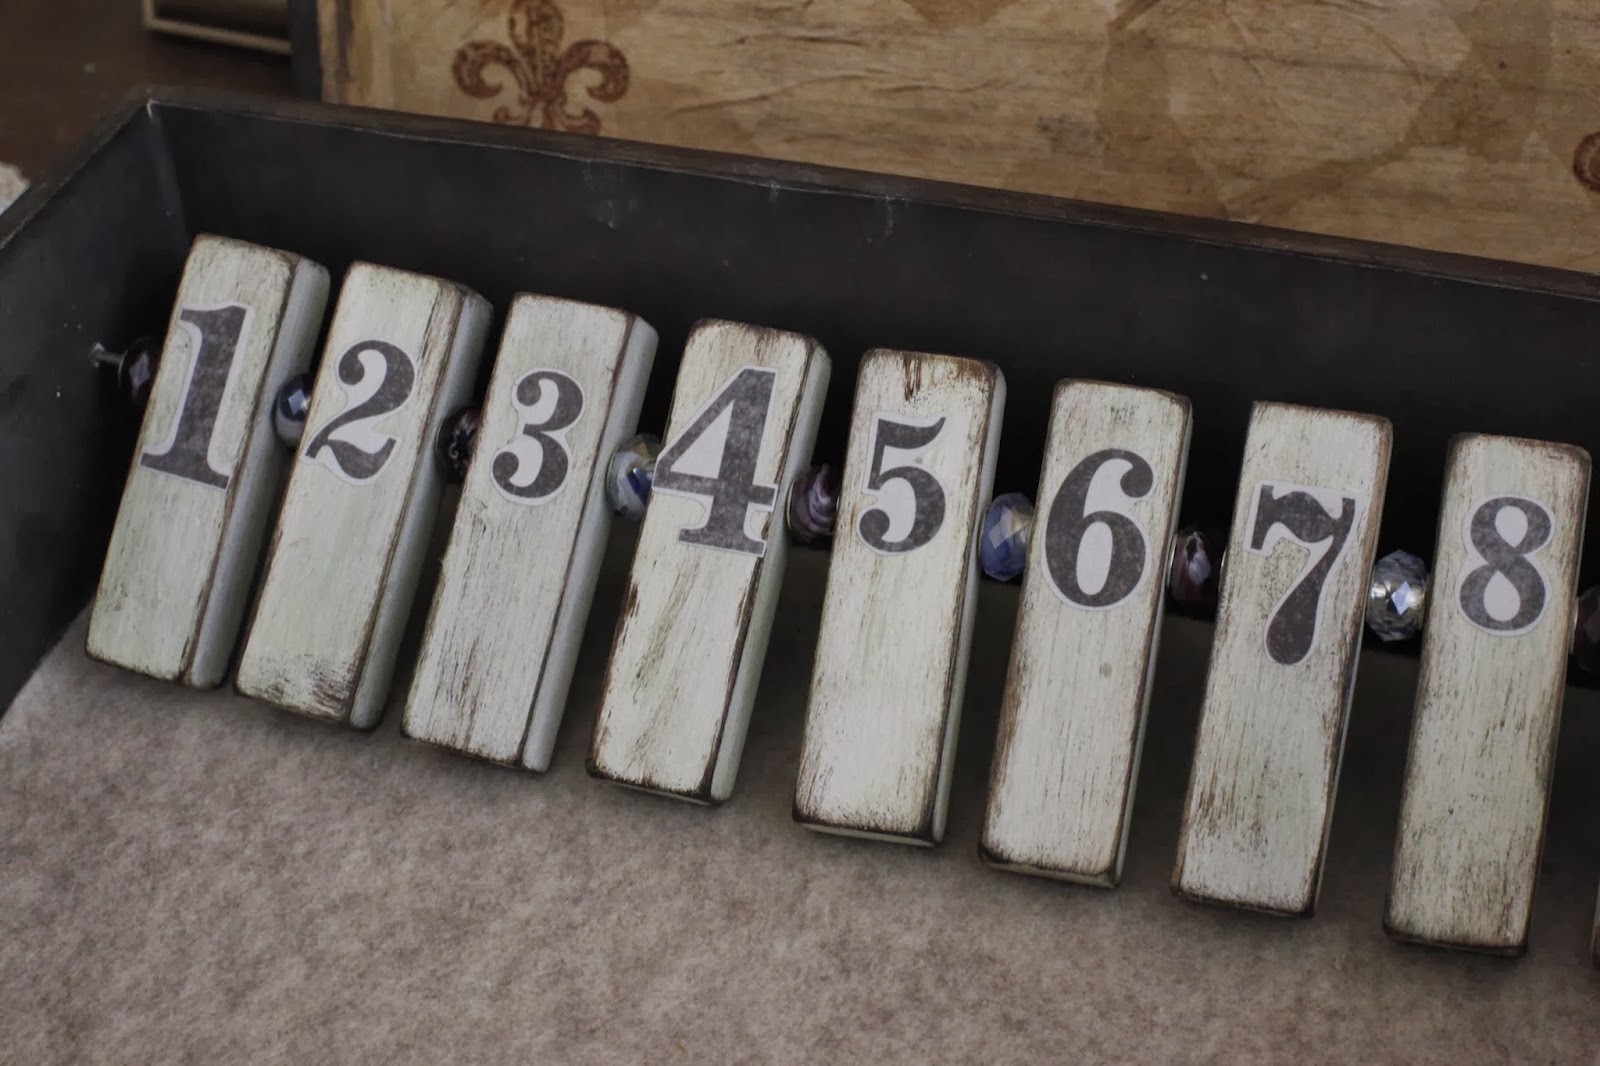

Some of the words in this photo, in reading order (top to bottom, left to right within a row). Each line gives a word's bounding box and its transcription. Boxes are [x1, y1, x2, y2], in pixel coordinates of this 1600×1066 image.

[140, 305, 246, 489] 1
[306, 340, 415, 480] 2
[492, 370, 584, 499] 3
[653, 367, 776, 556] 4
[859, 416, 947, 553] 5
[1045, 448, 1155, 607] 6
[1250, 484, 1356, 665] 7
[1459, 496, 1553, 631] 8
